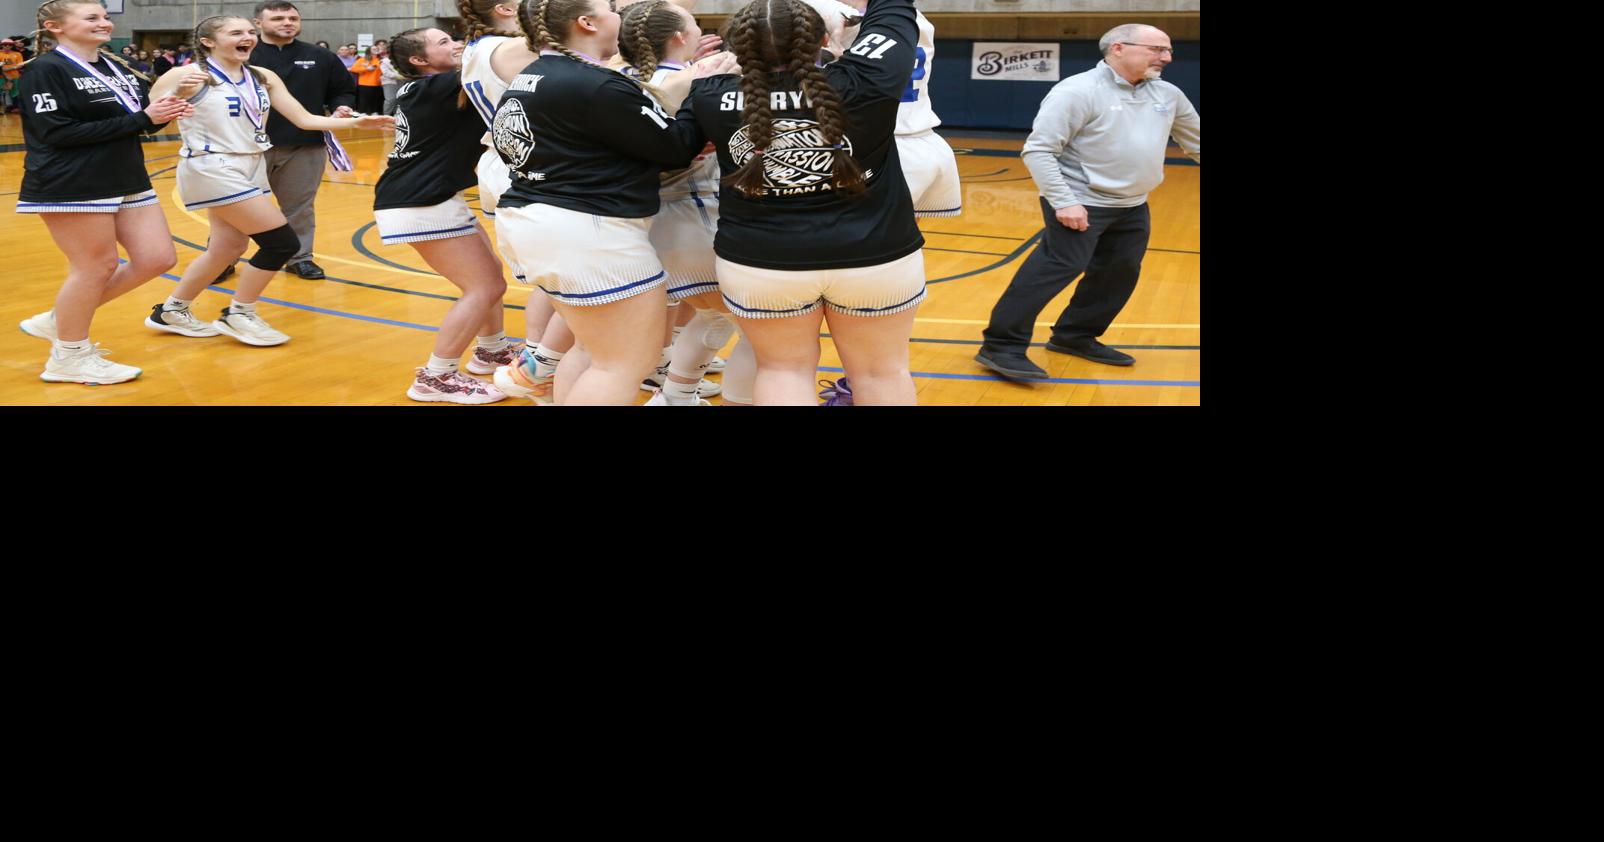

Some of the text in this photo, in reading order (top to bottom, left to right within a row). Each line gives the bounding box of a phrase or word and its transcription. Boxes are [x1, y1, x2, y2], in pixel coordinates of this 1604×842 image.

[977, 50, 1053, 76] BIRKETT
[1005, 62, 1029, 73] MILLS
[32, 93, 58, 114] 25
[225, 96, 241, 117] 3
[772, 186, 816, 197] THAN
[821, 182, 832, 191] A
